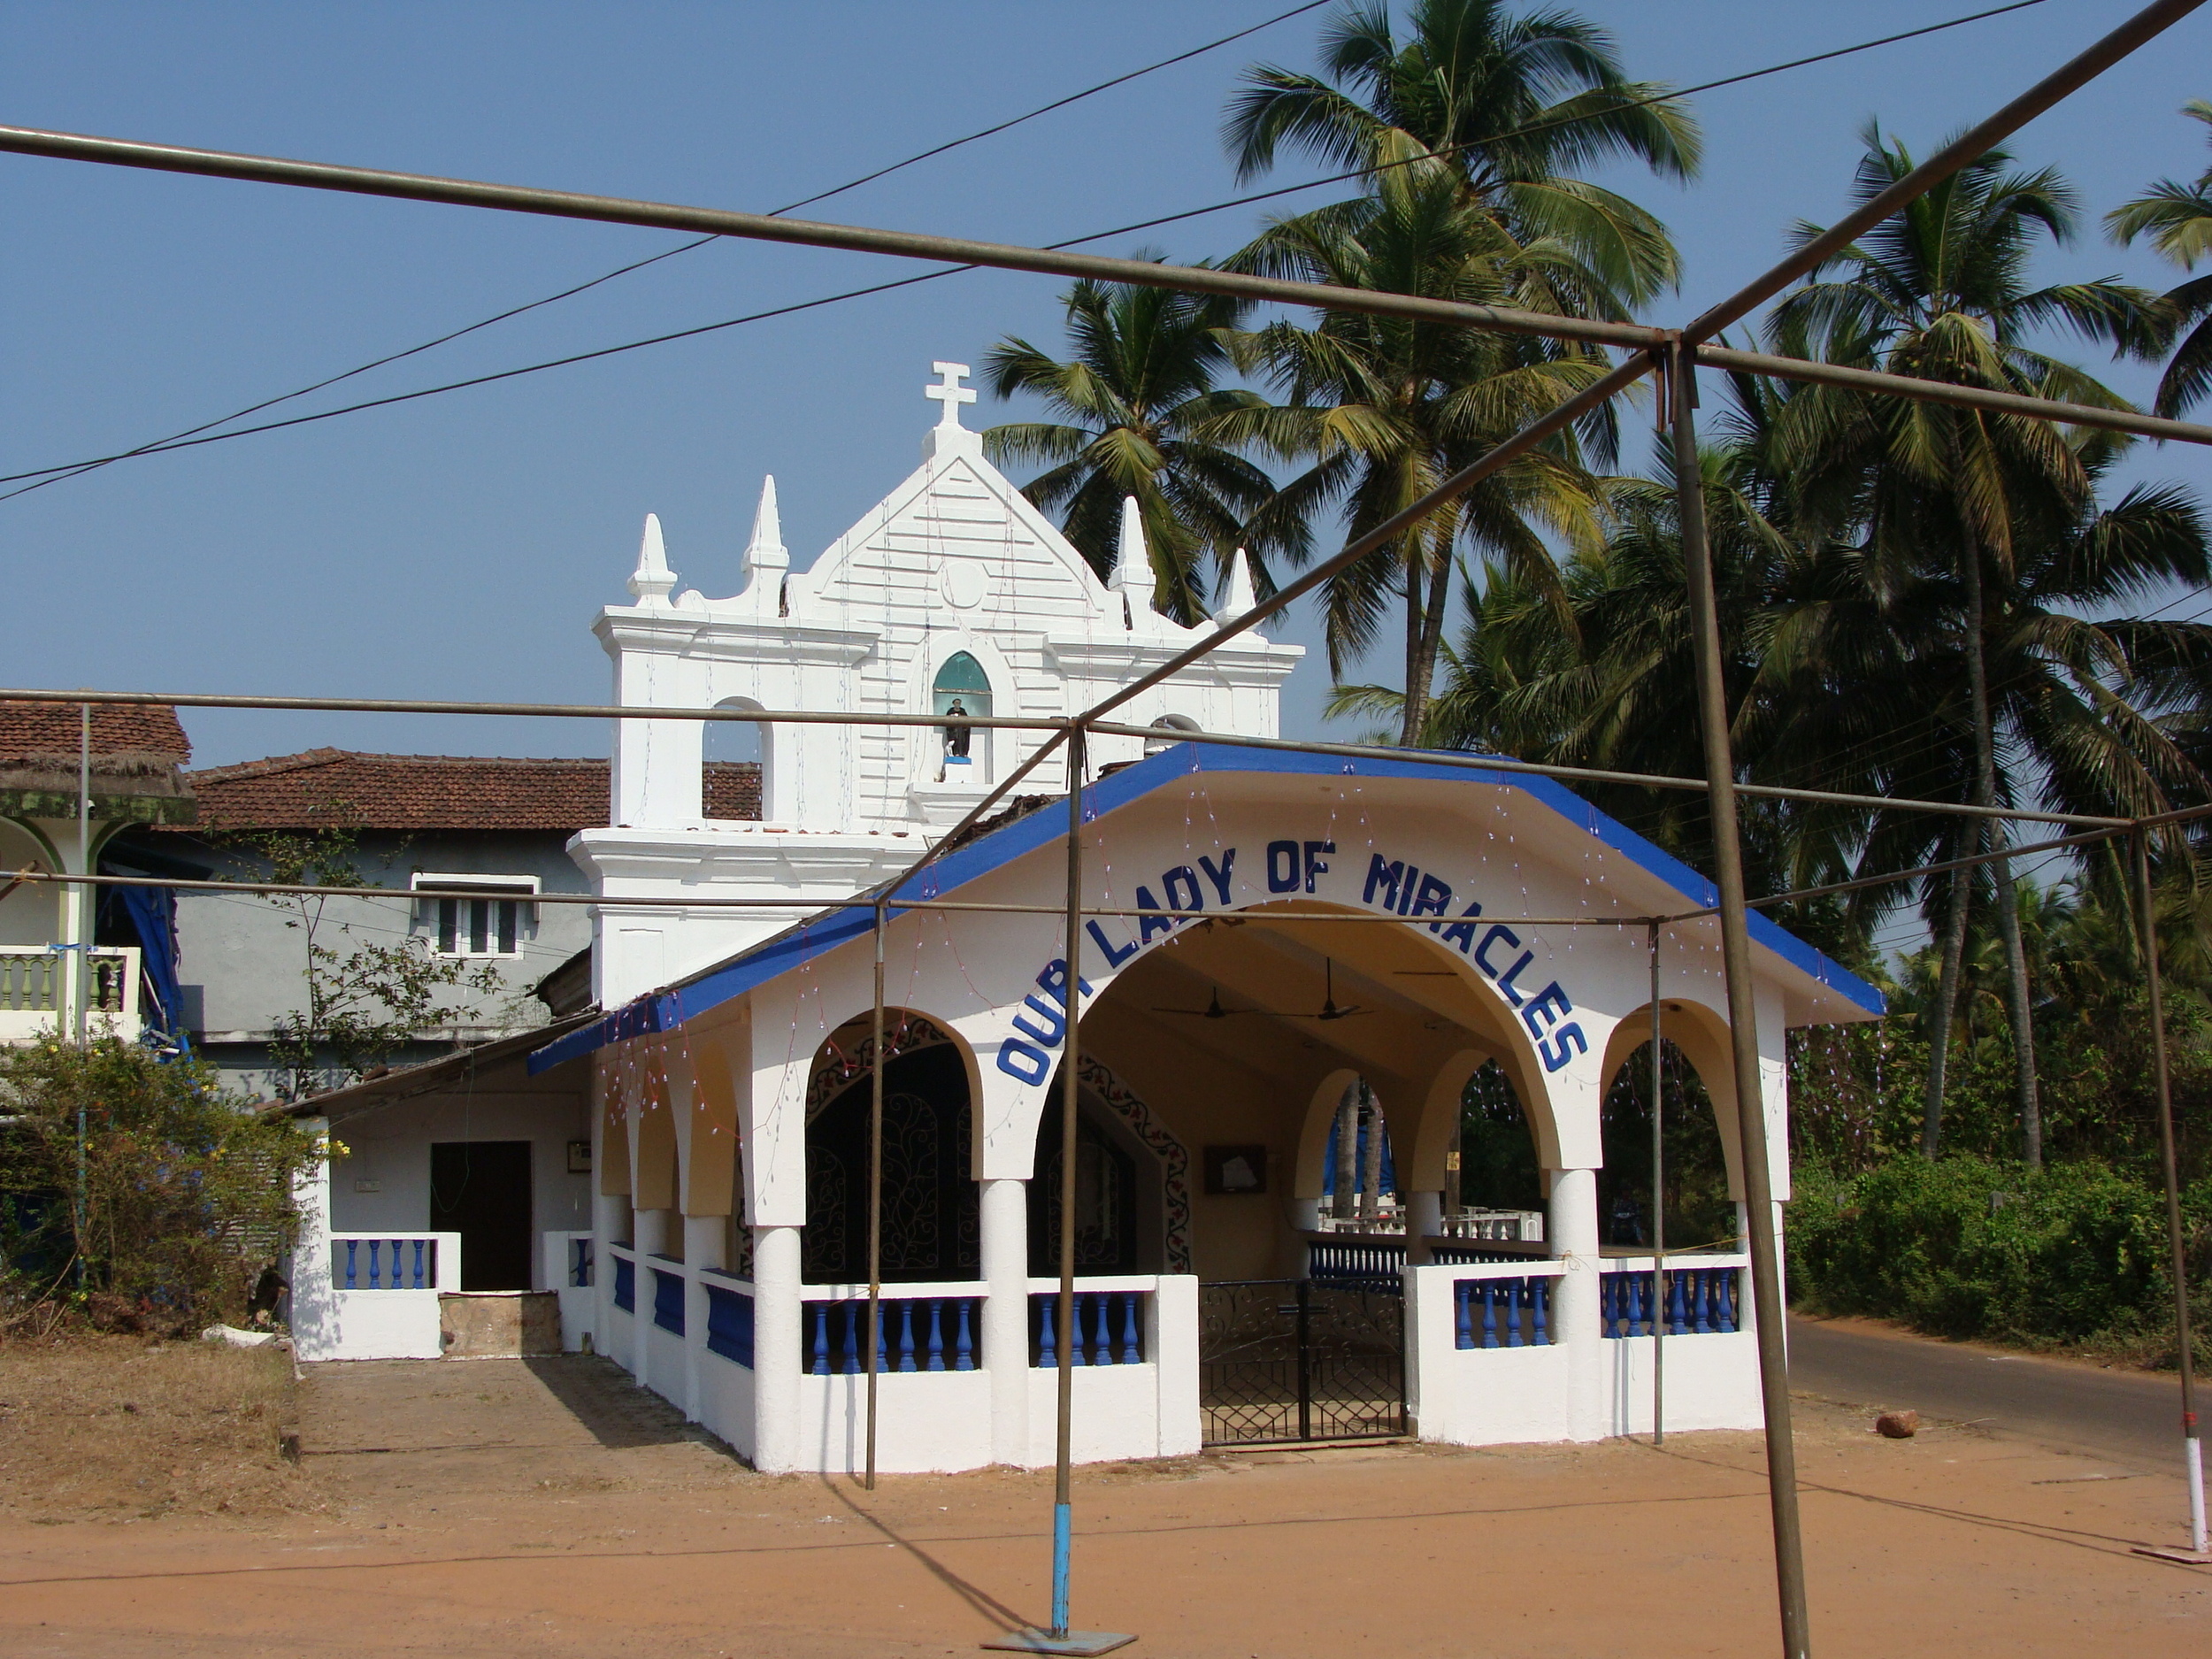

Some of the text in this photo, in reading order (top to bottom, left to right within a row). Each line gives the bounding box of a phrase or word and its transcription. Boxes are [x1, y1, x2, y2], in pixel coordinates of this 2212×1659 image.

[996, 841, 1588, 1087] OUR LADY OF MIRACLES
